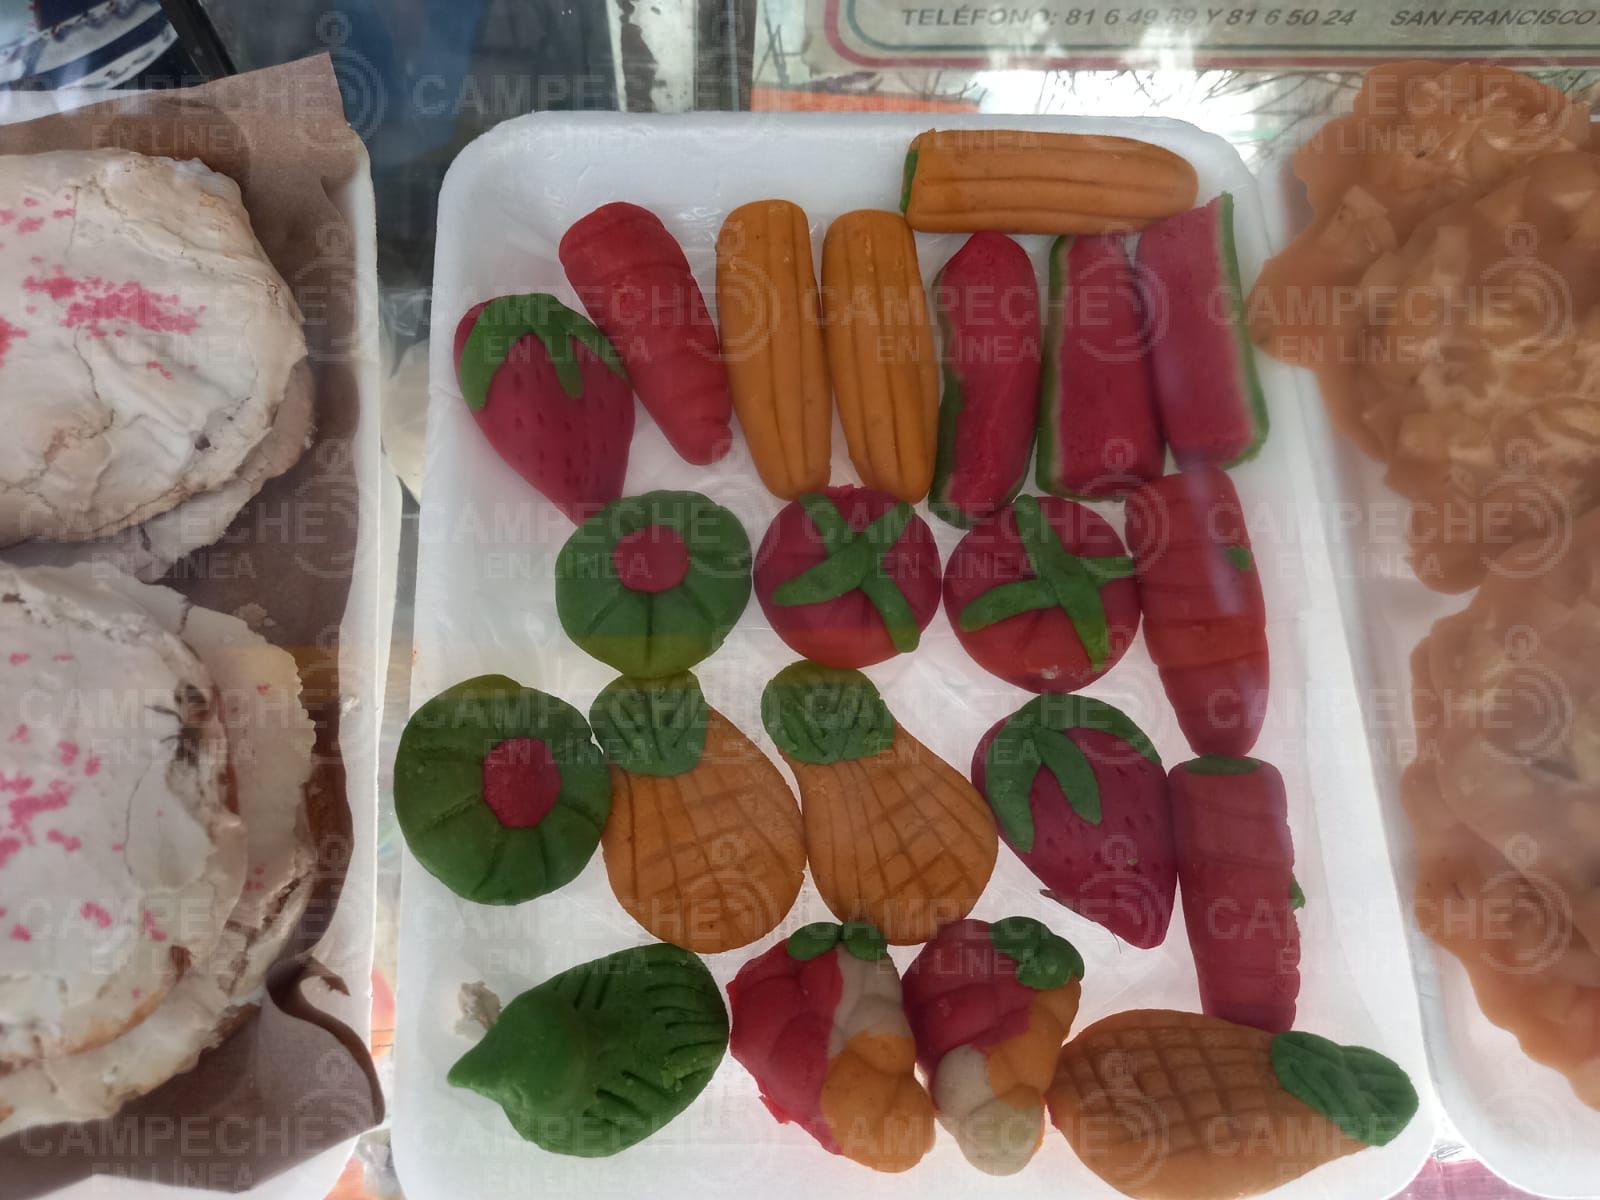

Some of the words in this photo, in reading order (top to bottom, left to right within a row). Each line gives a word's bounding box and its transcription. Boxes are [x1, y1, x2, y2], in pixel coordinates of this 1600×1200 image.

[1065, 8, 1095, 26] 81
[1104, 8, 1121, 26] 6
[1206, 8, 1224, 25] Y
[1225, 8, 1257, 26] 81
[1262, 8, 1283, 26] 6
[1284, 8, 1318, 26] 50
[1320, 8, 1357, 26] 24
[1390, 8, 1446, 27] SAN
[1447, 8, 1596, 27] FRANCISCO
